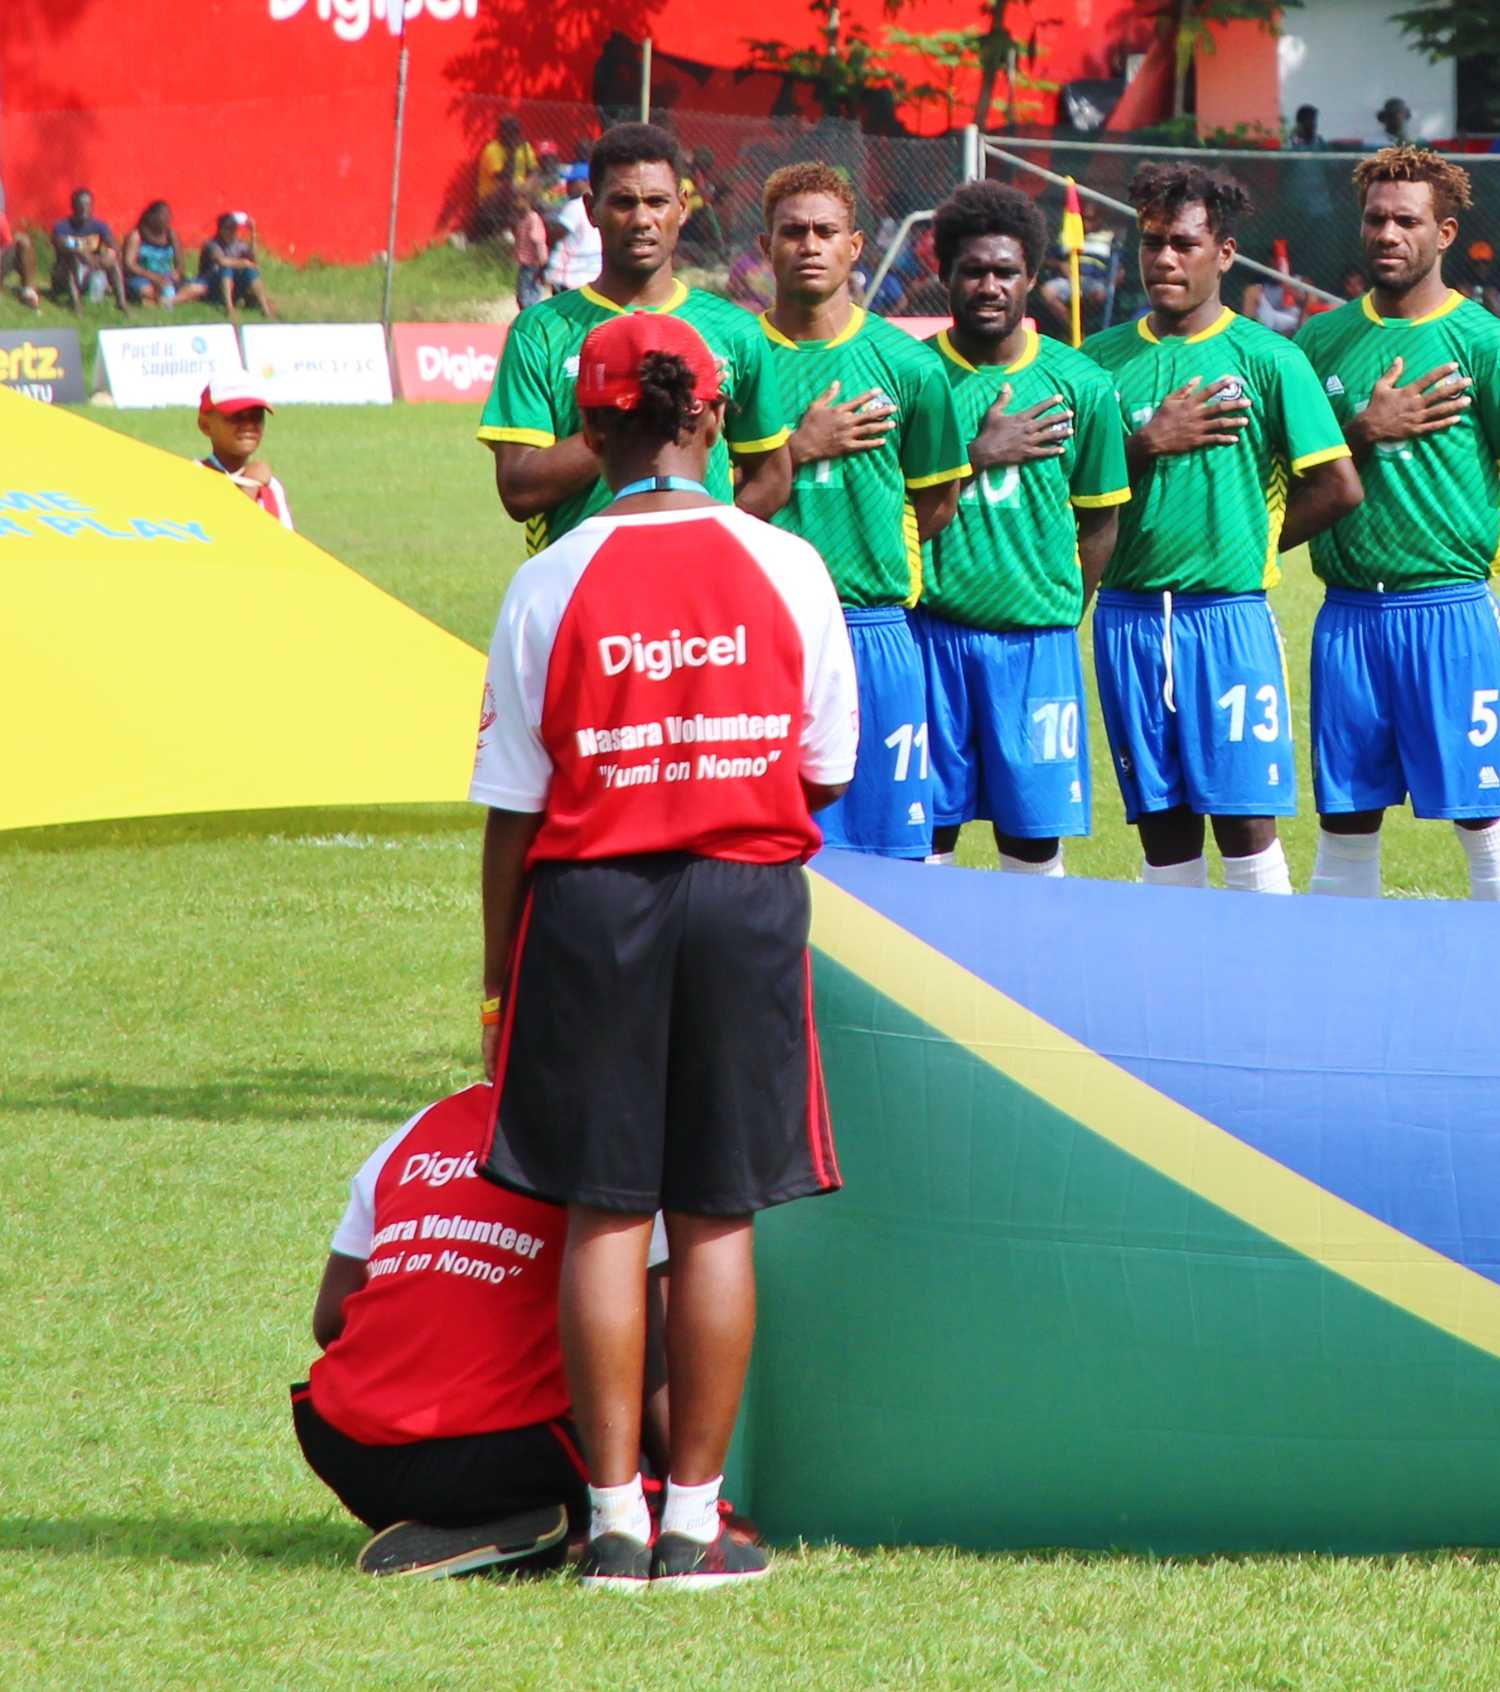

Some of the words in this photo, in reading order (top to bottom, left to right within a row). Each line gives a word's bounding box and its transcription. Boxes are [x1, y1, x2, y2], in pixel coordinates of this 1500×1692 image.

[38, 515, 213, 544] PLAY
[598, 625, 746, 680] Digicel
[576, 722, 664, 758] Nasara
[665, 713, 792, 745] Volunteer
[1032, 701, 1078, 760] 10
[1218, 684, 1279, 743] 13
[1467, 689, 1500, 748] 5
[664, 761, 691, 782] on
[884, 722, 927, 782] 11
[420, 1214, 544, 1260] Volunteer
[405, 1253, 432, 1272] on
